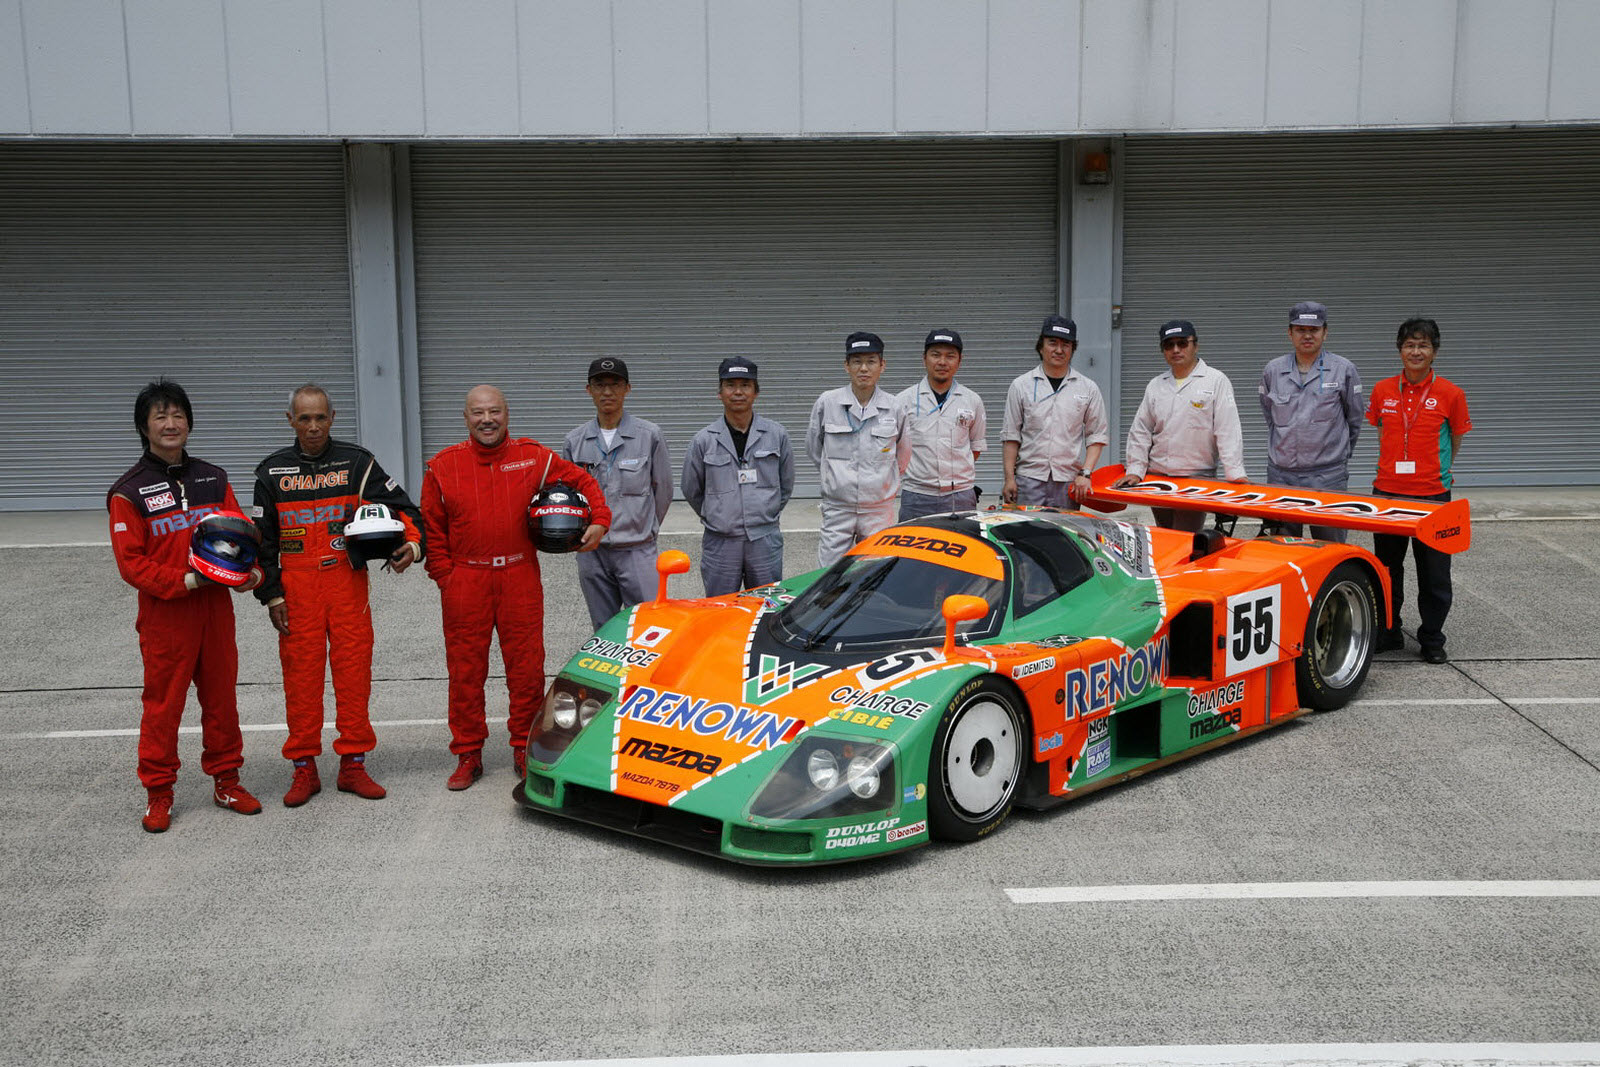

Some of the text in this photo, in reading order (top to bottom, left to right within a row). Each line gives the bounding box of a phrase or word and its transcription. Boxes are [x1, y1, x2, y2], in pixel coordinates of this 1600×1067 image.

[280, 470, 349, 491] CHARGE
[147, 493, 174, 506] NGK
[535, 507, 583, 516] AutoExe
[1435, 526, 1461, 540] mazda
[874, 535, 968, 558] mazda
[1097, 561, 1109, 572] 55
[1233, 596, 1273, 661] 55
[579, 637, 662, 668] CHARGE
[1021, 658, 1055, 676] IDEMITSU
[829, 686, 931, 720] CHARGE
[949, 680, 984, 714] DUNLOP
[1187, 680, 1245, 718] CHARGE
[614, 686, 798, 750] RENOWN
[1088, 716, 1109, 738] NGK
[1189, 707, 1242, 740] mazda
[619, 737, 722, 775] mazda
[621, 772, 681, 793] MAZDA 787B
[825, 818, 900, 838] DUNLOP
[896, 824, 925, 838] brembo
